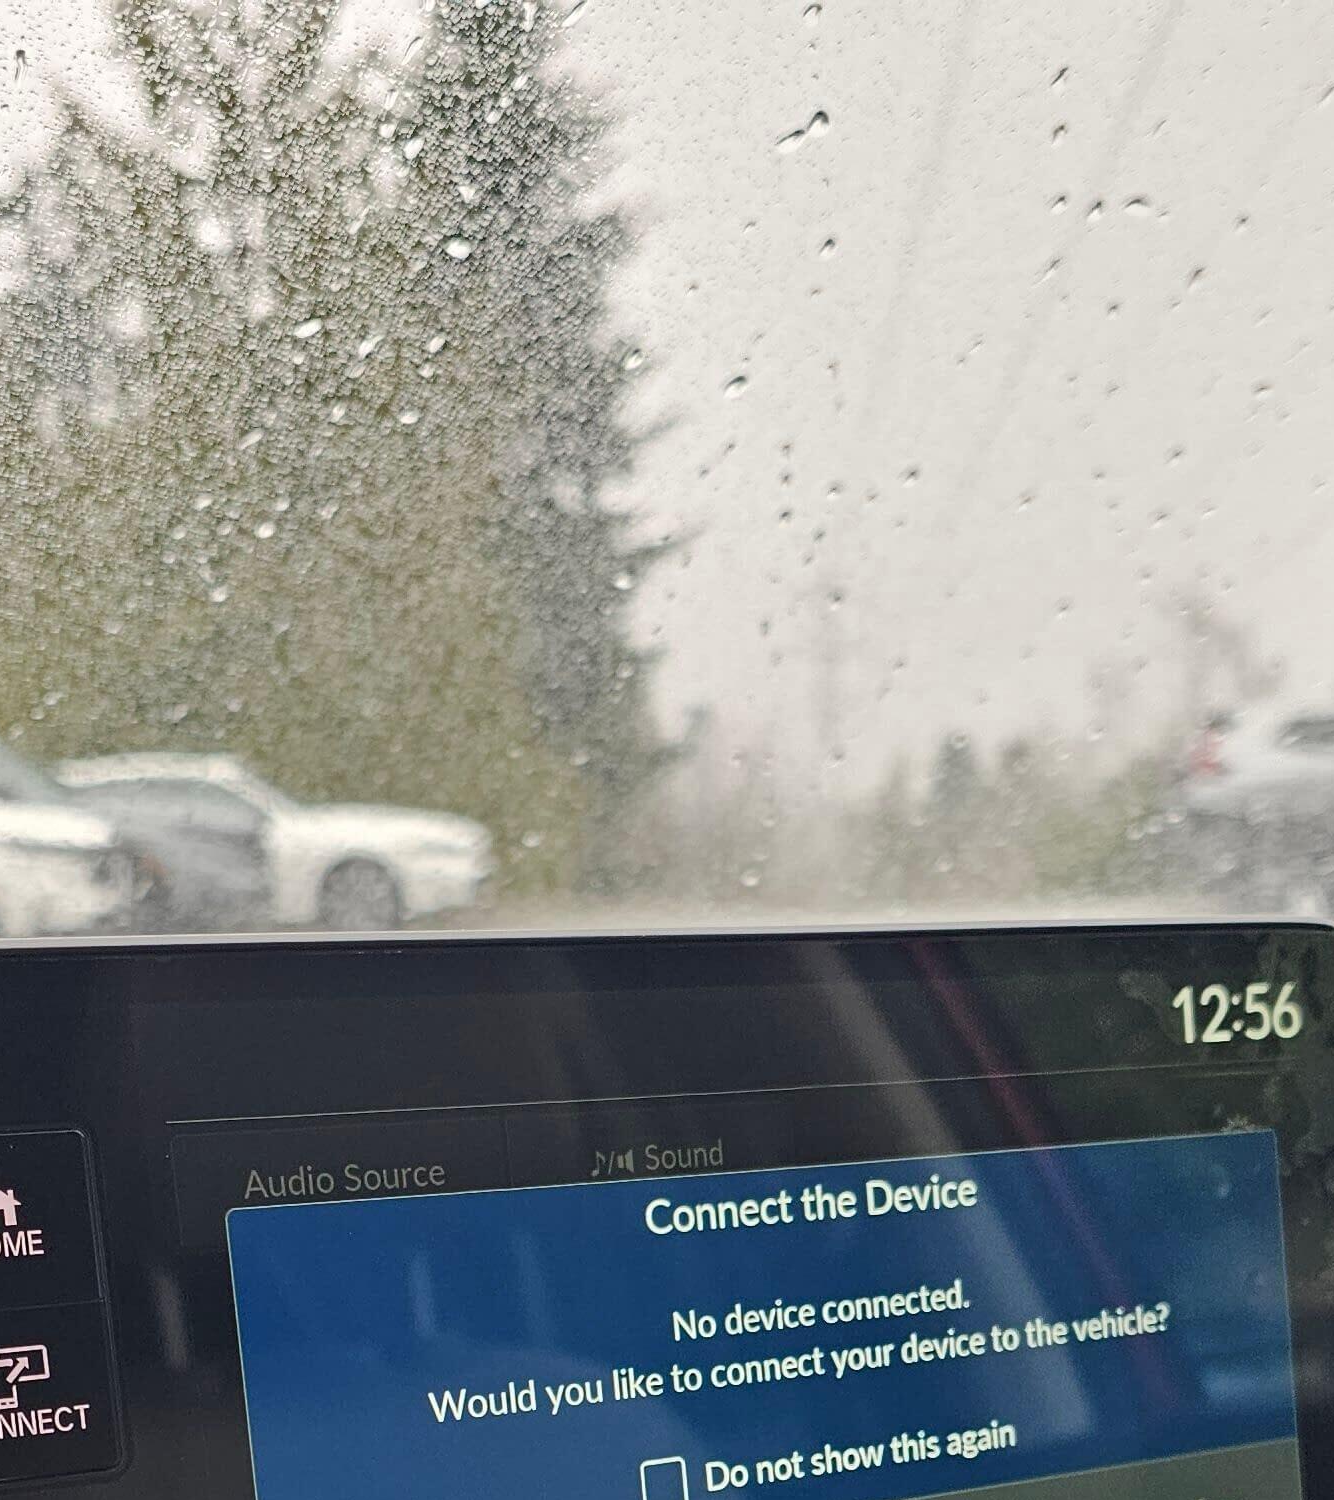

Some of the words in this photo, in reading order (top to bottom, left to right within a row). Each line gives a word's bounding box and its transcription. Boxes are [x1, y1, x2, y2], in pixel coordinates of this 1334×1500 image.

[1172, 981, 1304, 1044] 12:56
[244, 1167, 334, 1200] Audio
[345, 1161, 446, 1192] Source
[645, 1141, 724, 1170] Sound
[645, 1190, 794, 1235] Connect
[802, 1185, 858, 1222] the
[866, 1175, 978, 1217] Device
[673, 1308, 716, 1343] No
[725, 1298, 815, 1338] device
[823, 1279, 971, 1325] connected.
[428, 1380, 537, 1423] Would
[545, 1376, 604, 1417] you
[612, 1368, 664, 1404] like
[671, 1361, 703, 1394] to
[711, 1347, 825, 1389] connect
[832, 1341, 894, 1379] your
[901, 1328, 985, 1365] device
[992, 1324, 1019, 1353] to
[1026, 1315, 1068, 1349] the
[1073, 1302, 1171, 1342] vehicle?
[705, 1461, 748, 1493] Do
[757, 1452, 803, 1485] not
[811, 1439, 883, 1478] show
[890, 1431, 941, 1465] this
[947, 1420, 1017, 1461] again
